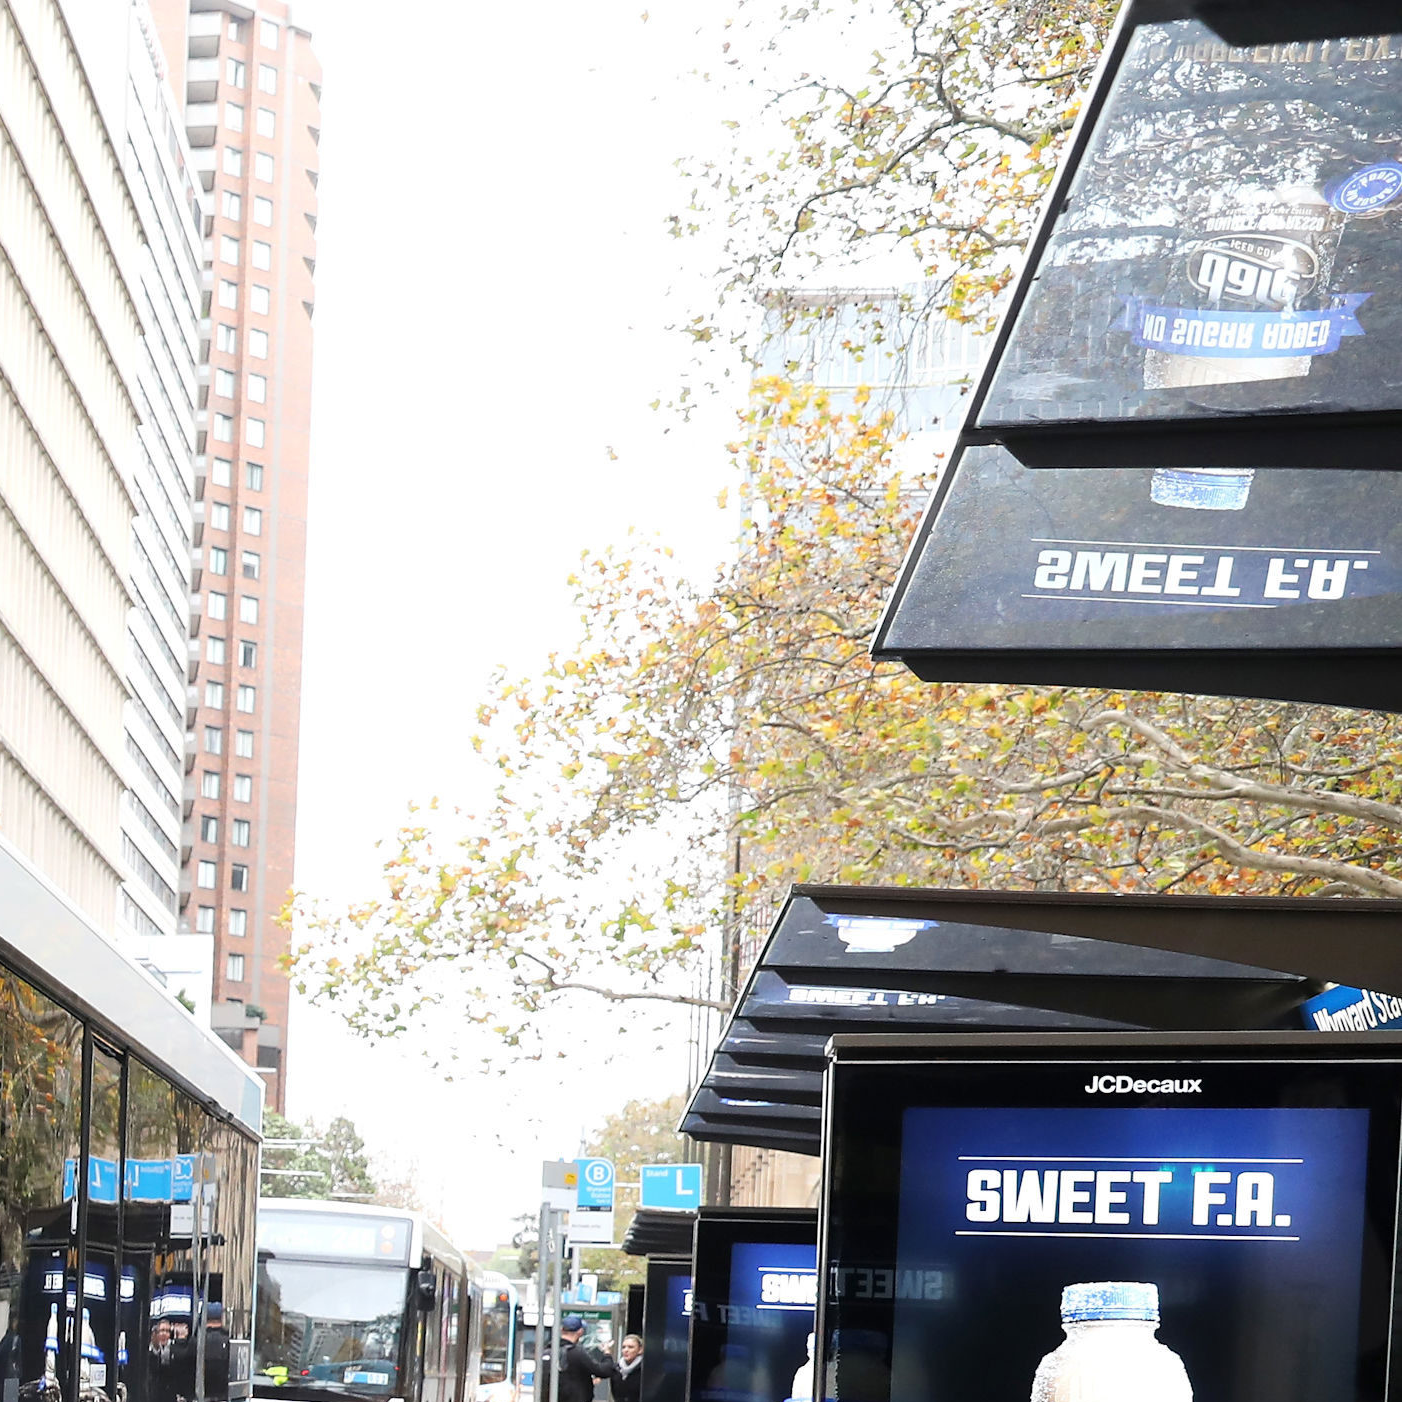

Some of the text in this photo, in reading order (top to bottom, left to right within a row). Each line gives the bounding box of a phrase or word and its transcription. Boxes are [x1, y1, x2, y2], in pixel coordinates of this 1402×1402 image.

[1085, 1075, 1202, 1094] JCDecaux
[675, 1168, 694, 1196] L
[965, 1169, 1292, 1228] SWEET F.A.
